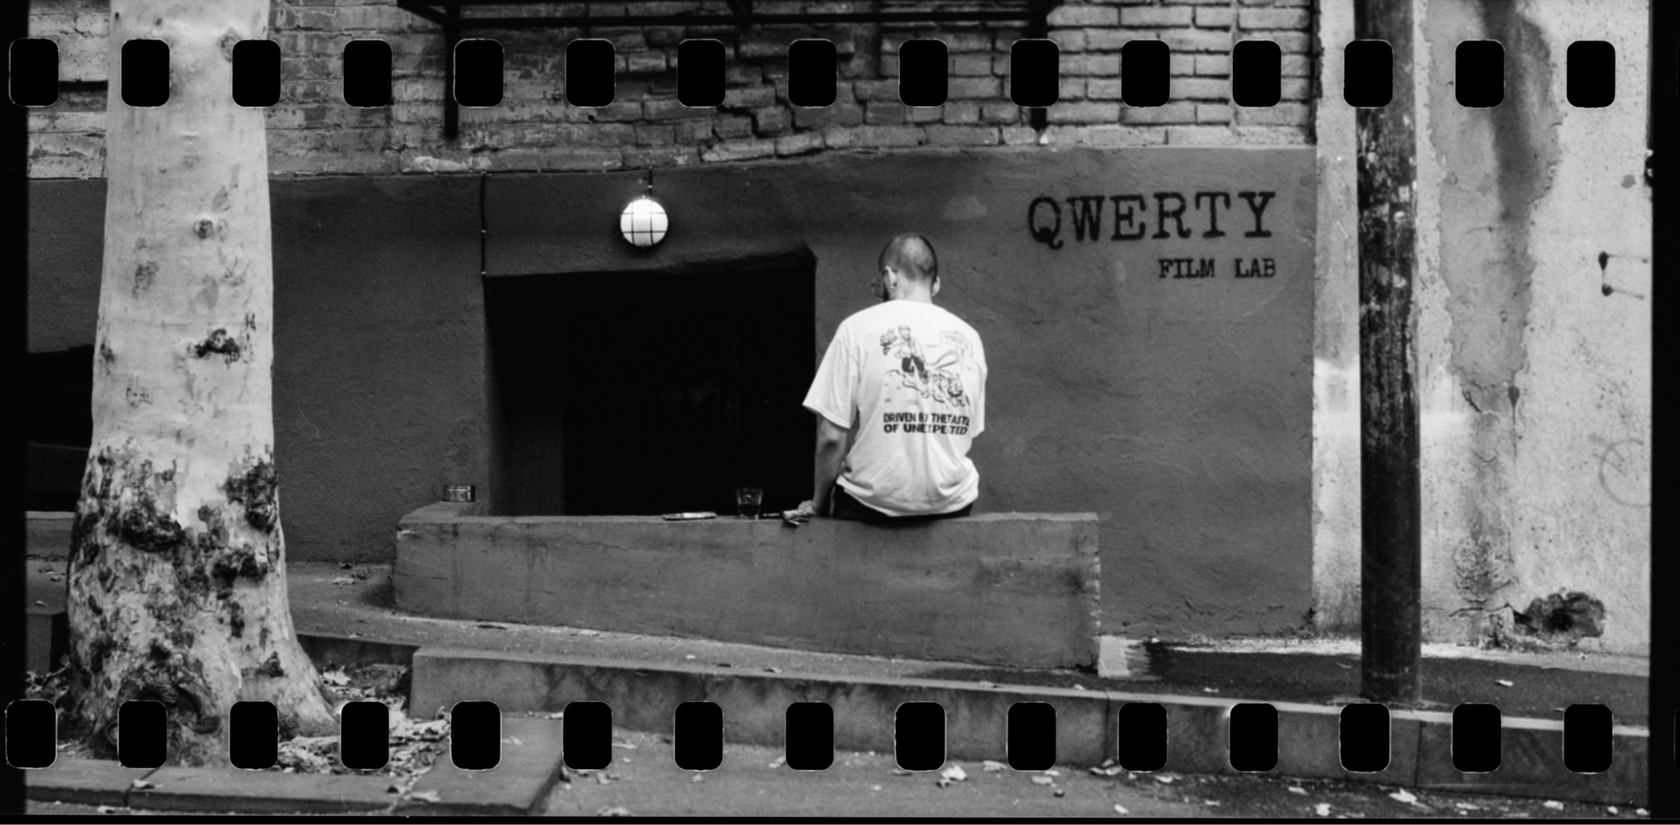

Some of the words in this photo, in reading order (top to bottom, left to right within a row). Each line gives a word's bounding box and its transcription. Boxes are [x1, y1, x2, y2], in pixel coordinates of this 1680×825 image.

[1028, 191, 1276, 250] QWERTY
[1158, 258, 1215, 279] FILM
[1234, 258, 1276, 279] LAB
[883, 412, 916, 423] DRIVEN
[931, 413, 946, 424] THE
[883, 423, 899, 434] OF
